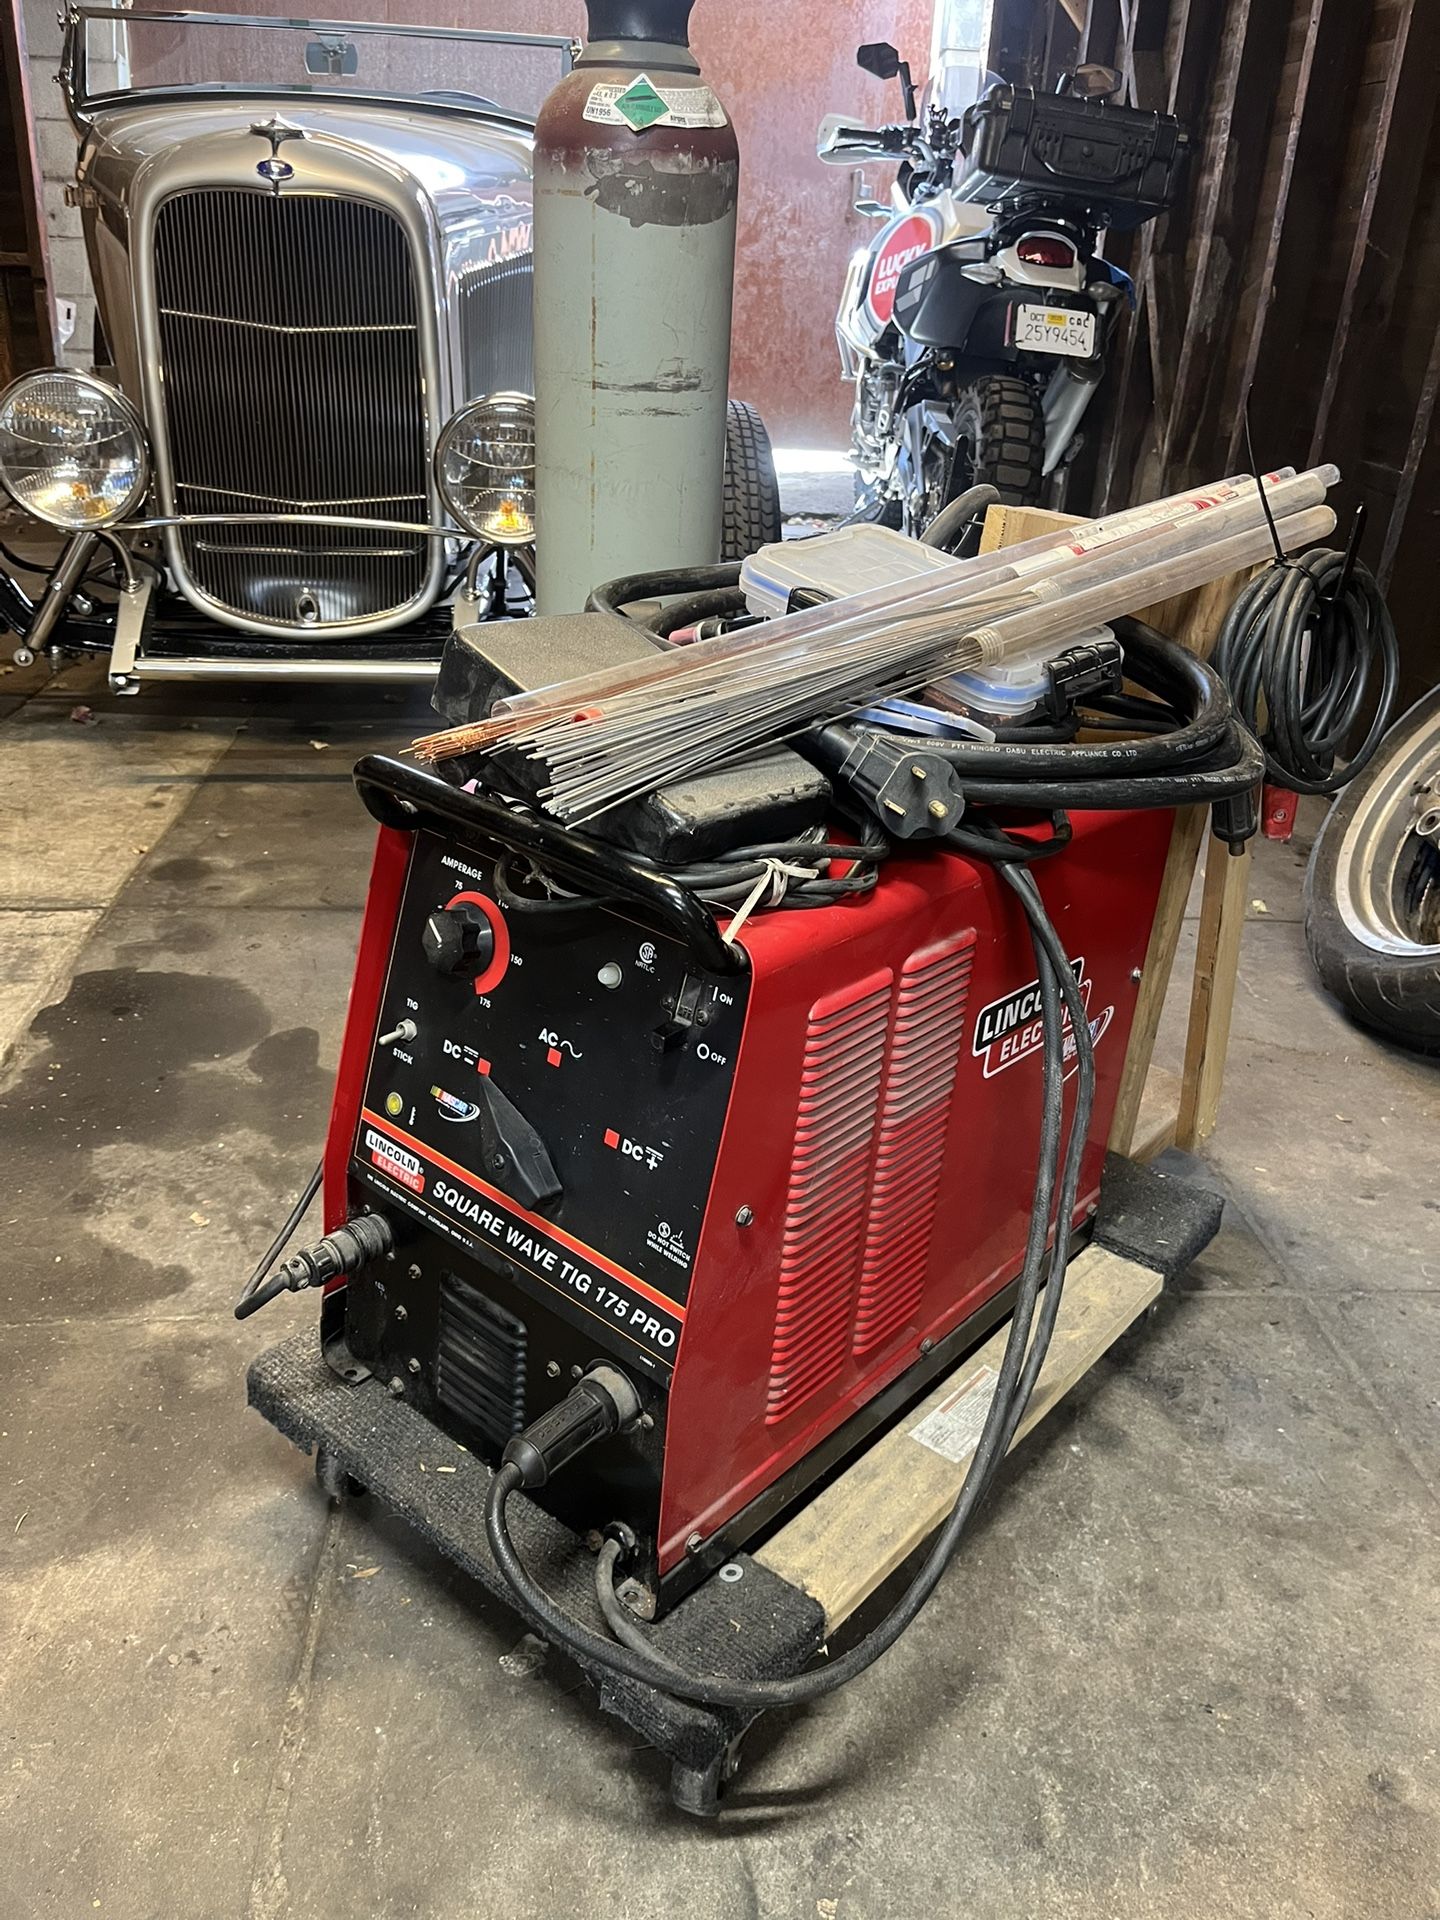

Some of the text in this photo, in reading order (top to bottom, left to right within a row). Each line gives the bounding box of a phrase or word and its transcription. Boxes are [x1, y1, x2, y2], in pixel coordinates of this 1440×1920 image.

[586, 106, 611, 117] UN1956
[1030, 312, 1045, 322] OCT
[1025, 323, 1087, 347] 25Y9454
[1031, 748, 1067, 757] ELECTRIC
[1070, 750, 1108, 758] APPLIANCE
[441, 855, 483, 881] AMPERAGE
[454, 880, 464, 890] 75
[511, 953, 524, 966] 150
[406, 997, 419, 1011] TIG
[479, 996, 492, 1009] 175
[720, 993, 733, 1006] ON
[538, 1027, 559, 1047] AC
[392, 1047, 414, 1065] STICK
[443, 1039, 462, 1059] DC
[710, 1052, 727, 1066] OFF
[369, 1134, 416, 1172] LINCOLN
[621, 1138, 644, 1161] DC
[377, 1156, 420, 1190] ELECTRIC
[646, 1238, 688, 1269] WHILE WELDING
[647, 1230, 691, 1262] DO NOT SWITCH
[432, 1180, 676, 1348] SQUARE WAVE TIG 175 PRO
